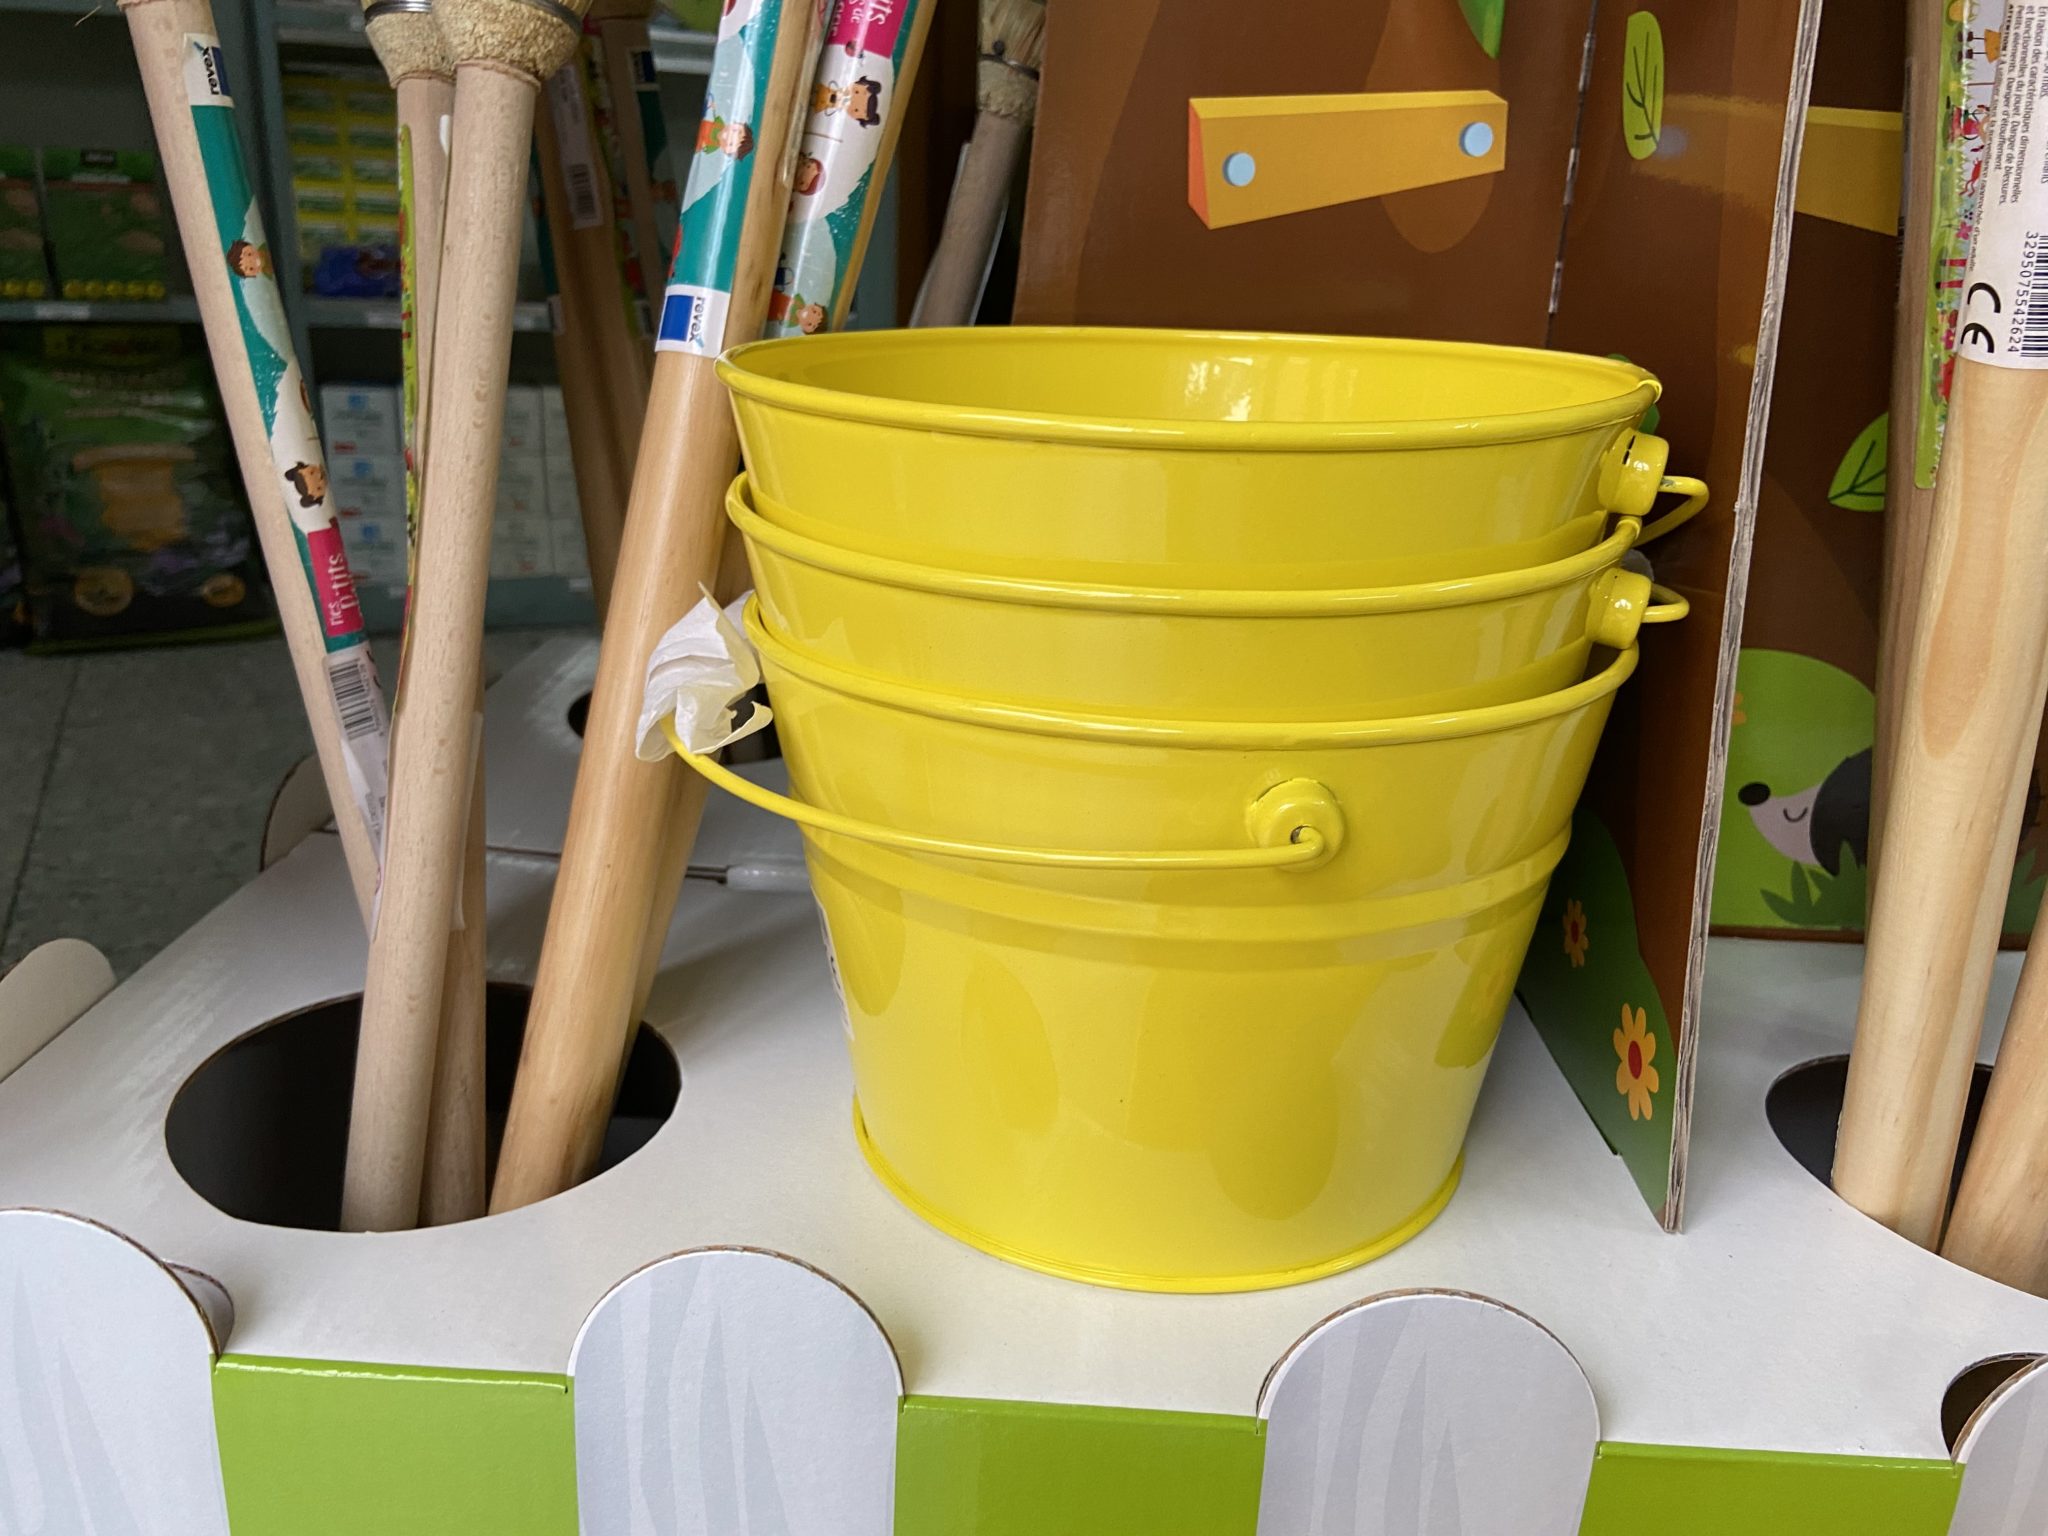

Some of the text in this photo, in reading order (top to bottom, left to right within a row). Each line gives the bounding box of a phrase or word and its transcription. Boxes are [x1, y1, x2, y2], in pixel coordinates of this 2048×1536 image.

[2014, 5, 2024, 30] Petits
[2026, 5, 2035, 14] et
[2018, 17, 2034, 78] fonctionnelles
[2003, 78, 2014, 107] Danger
[2016, 80, 2026, 92] du
[2011, 6, 2047, 204] En raison des caractéristiques dimensionnelles
[2007, 121, 2020, 151] Danger
[2005, 153, 2015, 164] de
[2008, 231, 2038, 353] 3295075542624
